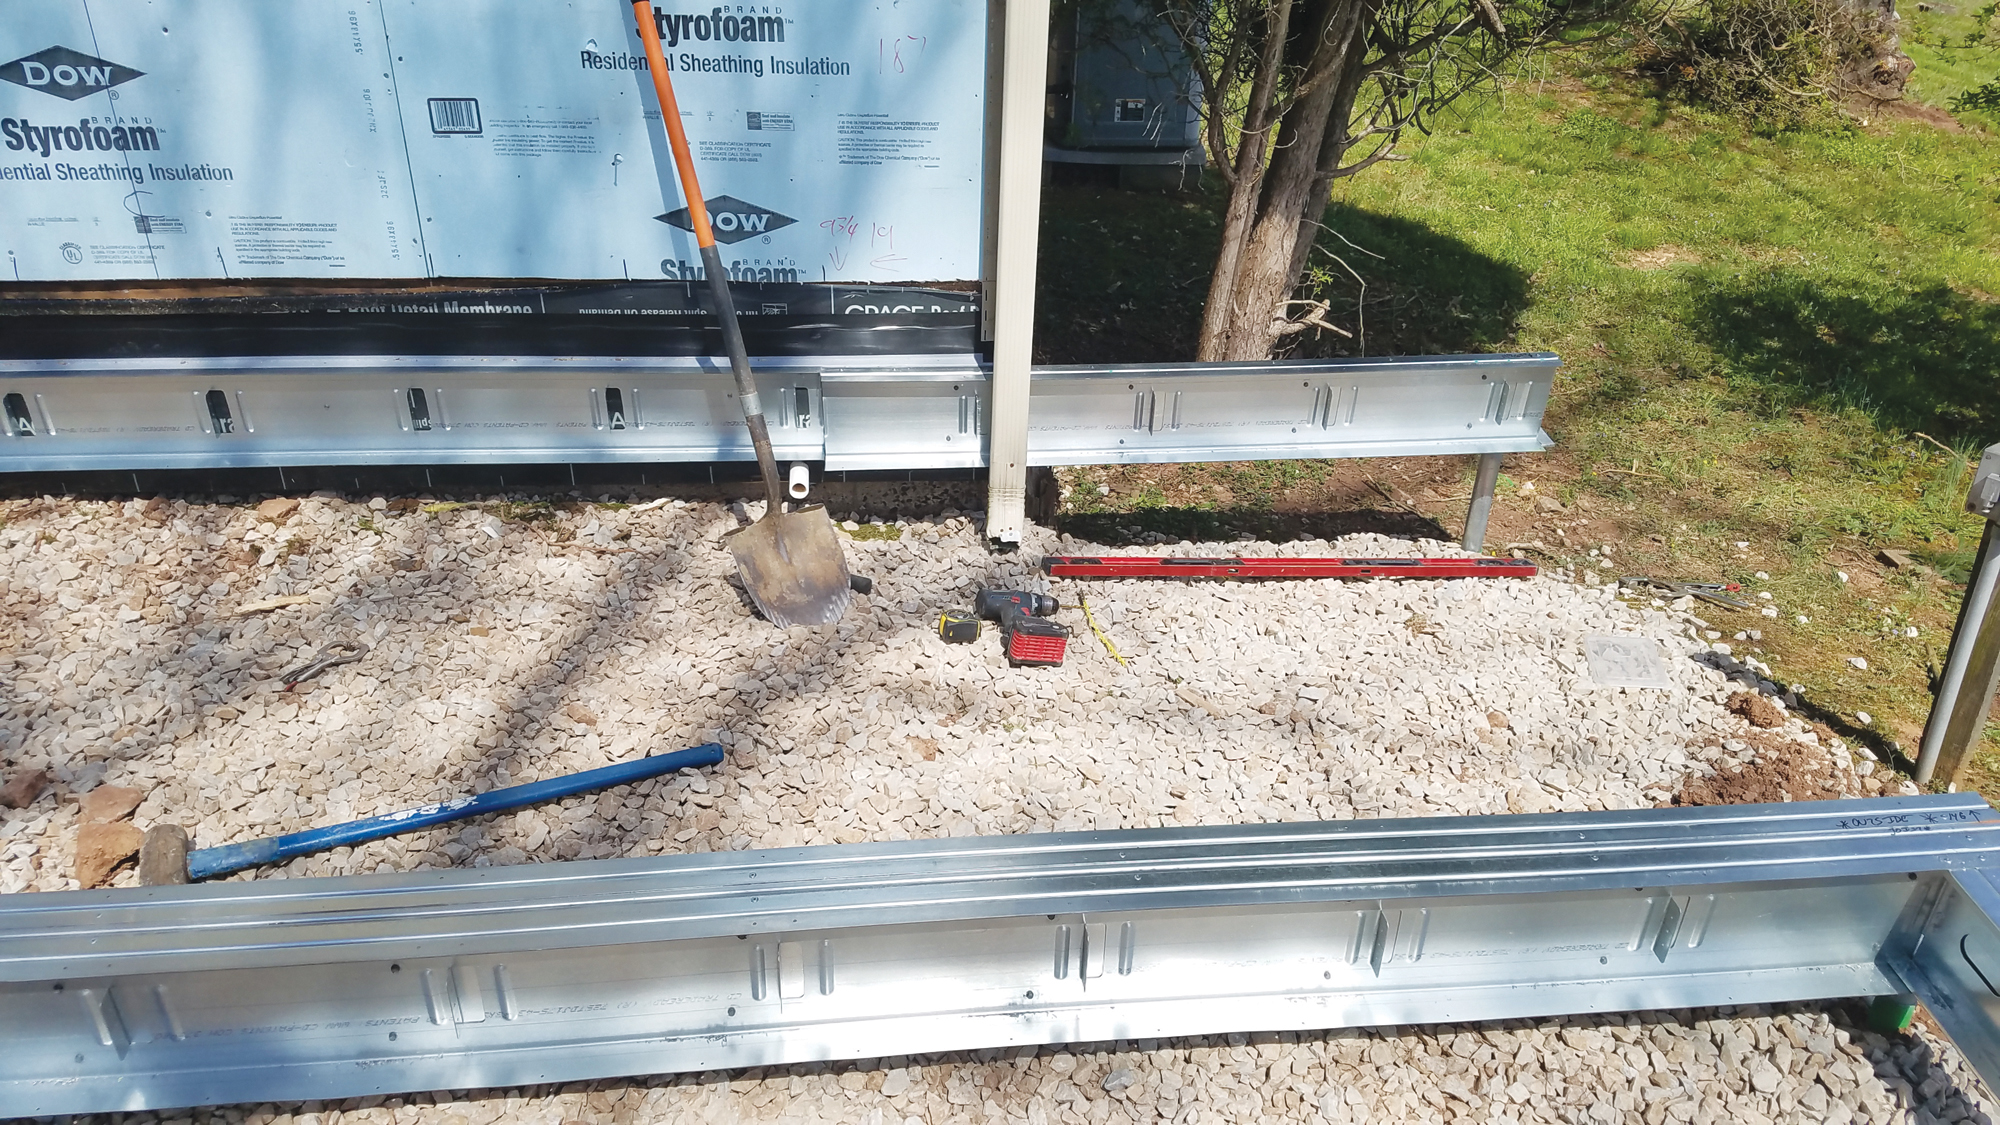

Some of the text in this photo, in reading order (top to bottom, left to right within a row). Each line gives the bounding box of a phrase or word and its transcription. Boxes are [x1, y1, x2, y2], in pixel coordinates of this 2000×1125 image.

[724, 5, 782, 14] BRAND
[20, 61, 113, 87] DOW
[580, 51, 850, 77] Residenal Sheathing Insulation
[91, 116, 153, 125] BRAND
[1, 118, 160, 157] Styrofoam
[0, 162, 234, 184] ential Sheathing Insulation
[661, 259, 798, 283] Styfoam
[743, 258, 796, 266] BRAND
